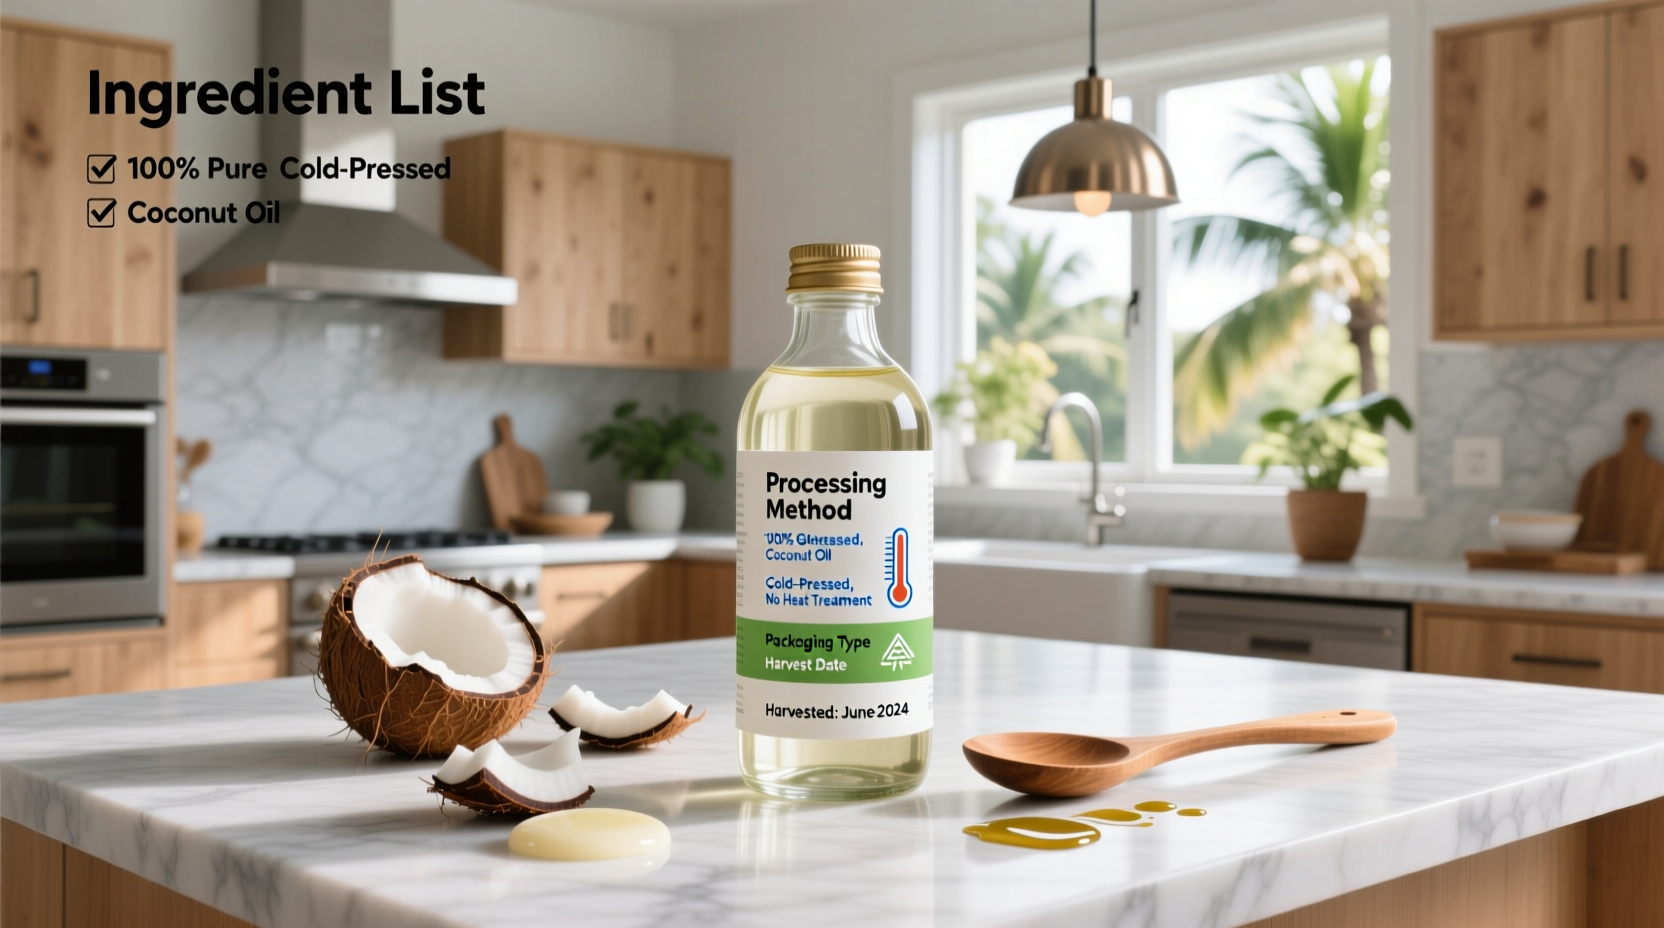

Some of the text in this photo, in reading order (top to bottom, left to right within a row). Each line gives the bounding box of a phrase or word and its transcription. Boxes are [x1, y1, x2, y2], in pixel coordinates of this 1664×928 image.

[766, 471, 887, 498] Processing
[766, 499, 852, 520] Method
[765, 548, 812, 561] Coconut
[765, 576, 854, 592] Cold-Pressed,
[765, 593, 780, 606] No
[783, 593, 809, 606] Heat
[837, 635, 871, 653] Type
[765, 657, 848, 671] Harvest Date
[765, 702, 909, 719] Harvested: June 2024
